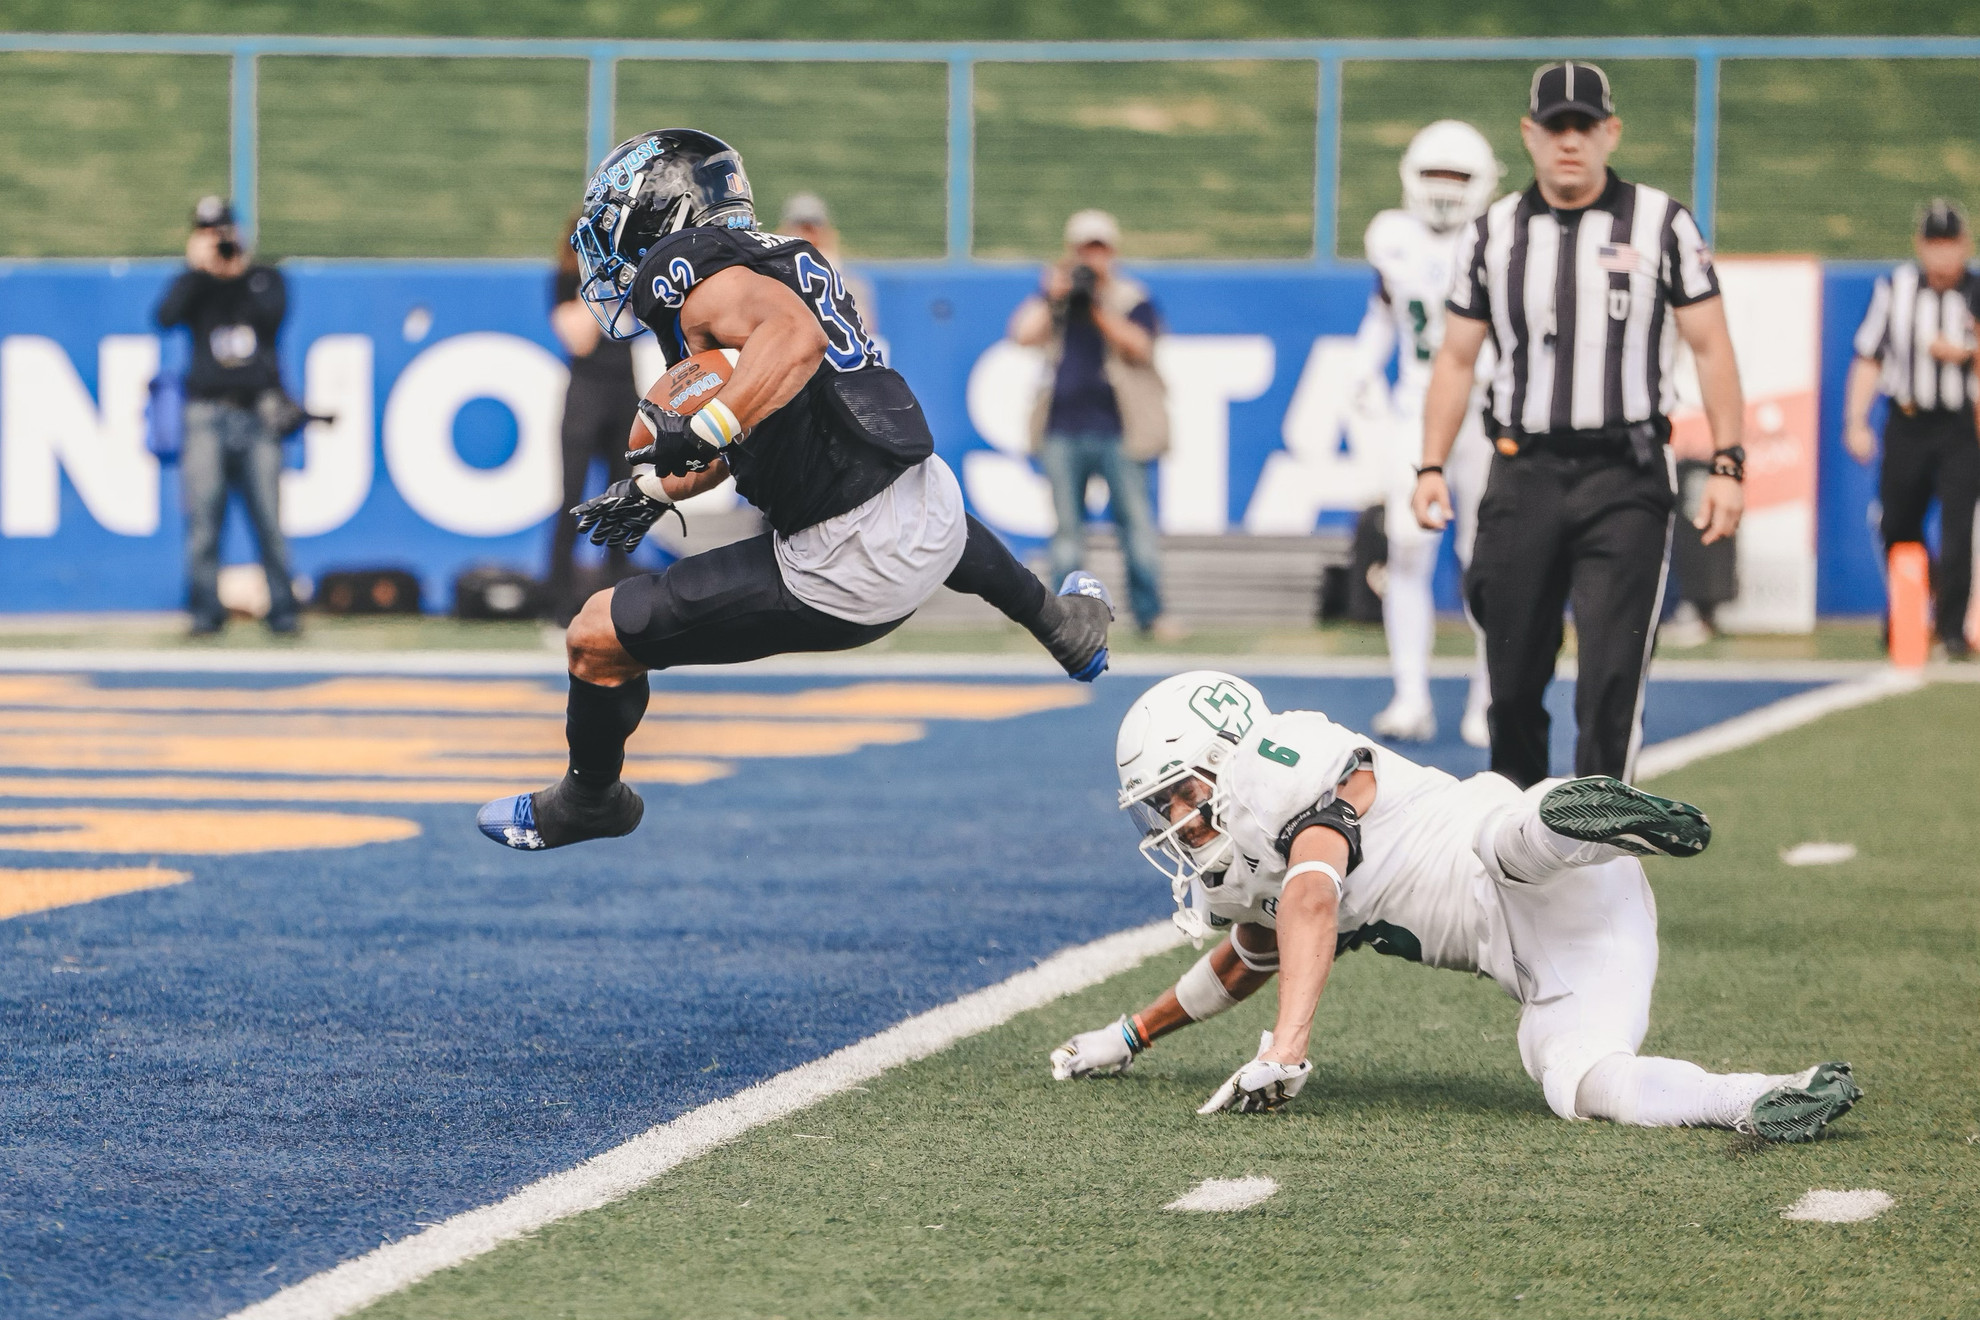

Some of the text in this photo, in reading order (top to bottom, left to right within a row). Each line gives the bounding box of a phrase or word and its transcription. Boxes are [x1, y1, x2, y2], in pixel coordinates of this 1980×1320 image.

[652, 256, 703, 308] 32
[668, 373, 724, 409] Wilson
[272, 332, 568, 538] JO
[963, 334, 1395, 537] STA
[1257, 737, 1301, 768] 6
